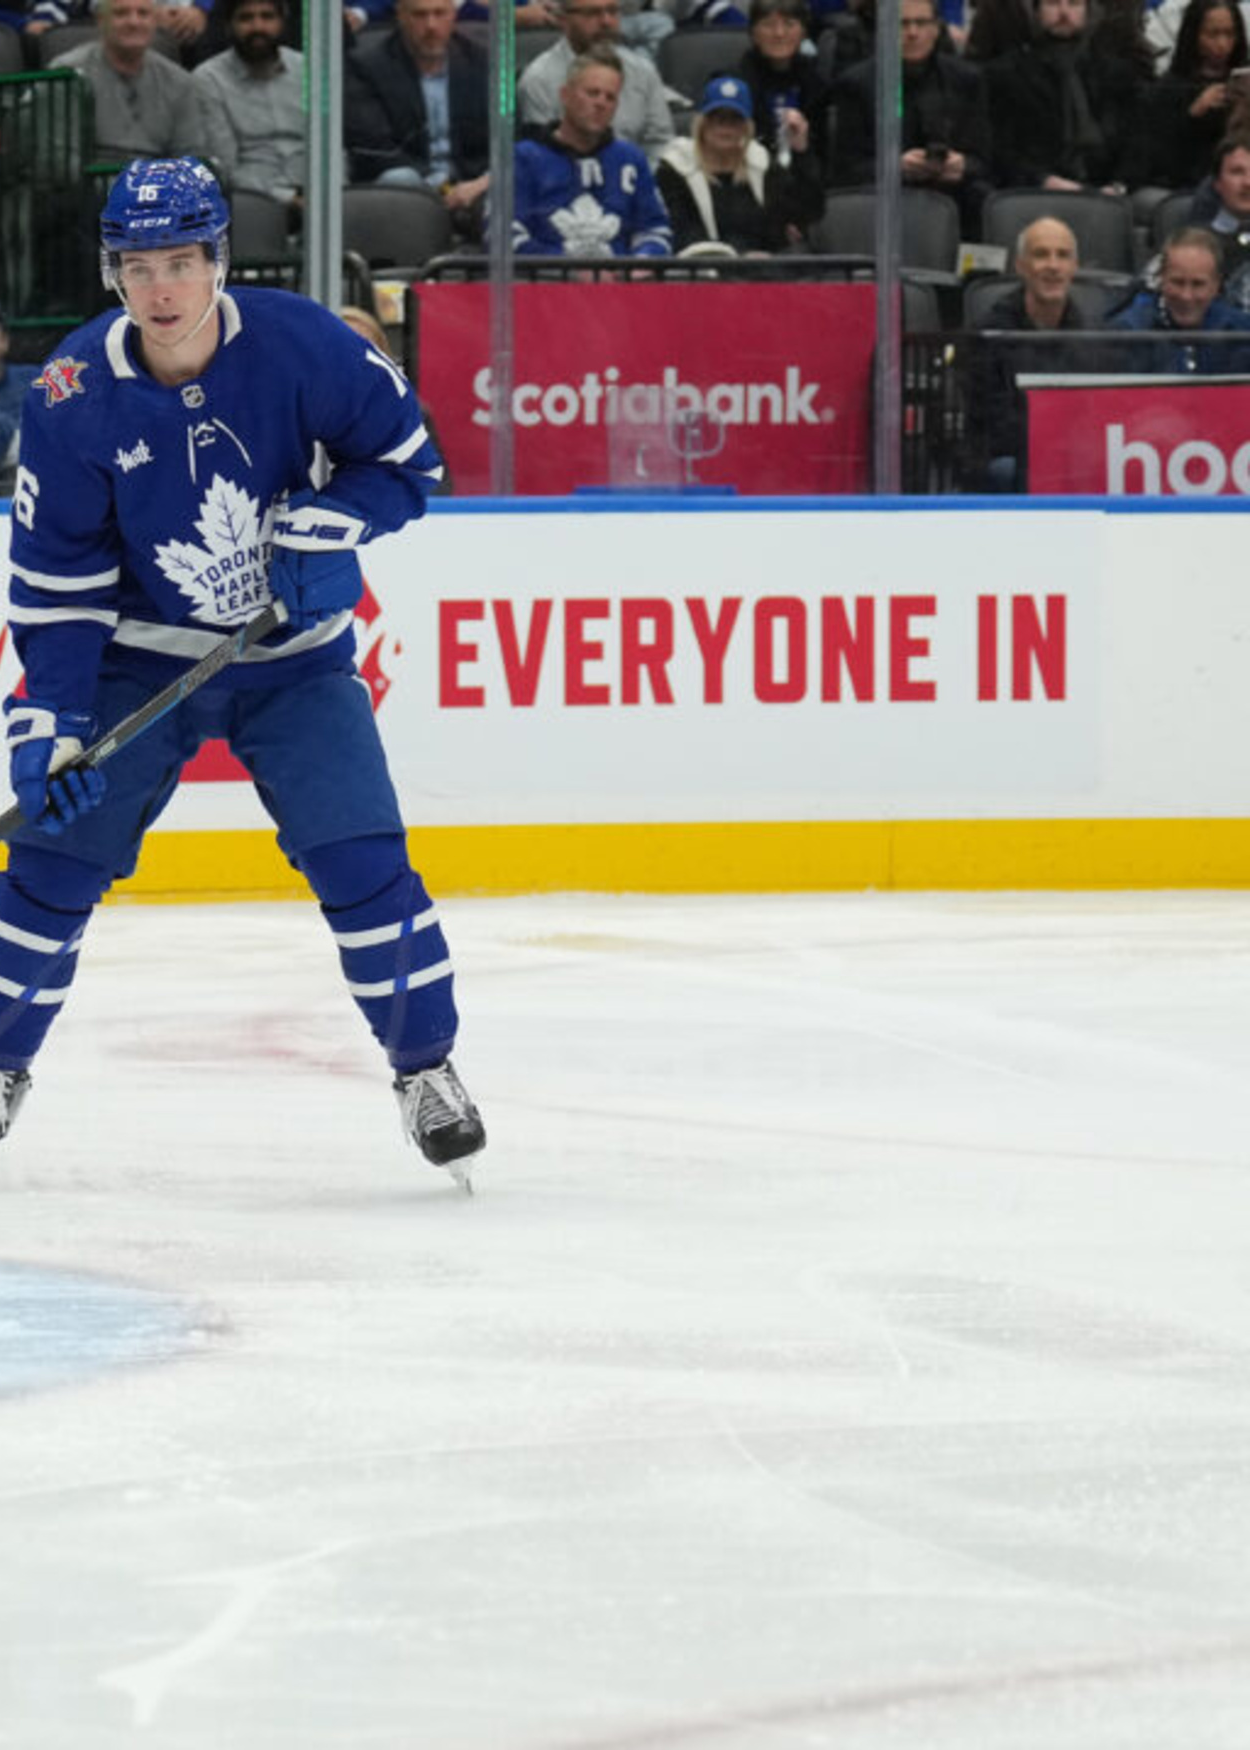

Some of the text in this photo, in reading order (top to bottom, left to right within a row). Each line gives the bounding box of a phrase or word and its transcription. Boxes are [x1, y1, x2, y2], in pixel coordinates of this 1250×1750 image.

[137, 185, 158, 202] 16
[193, 541, 274, 589] TORONT
[216, 583, 266, 615] LEAF
[440, 596, 935, 707] EVERYONE
[979, 595, 1065, 700] IN
